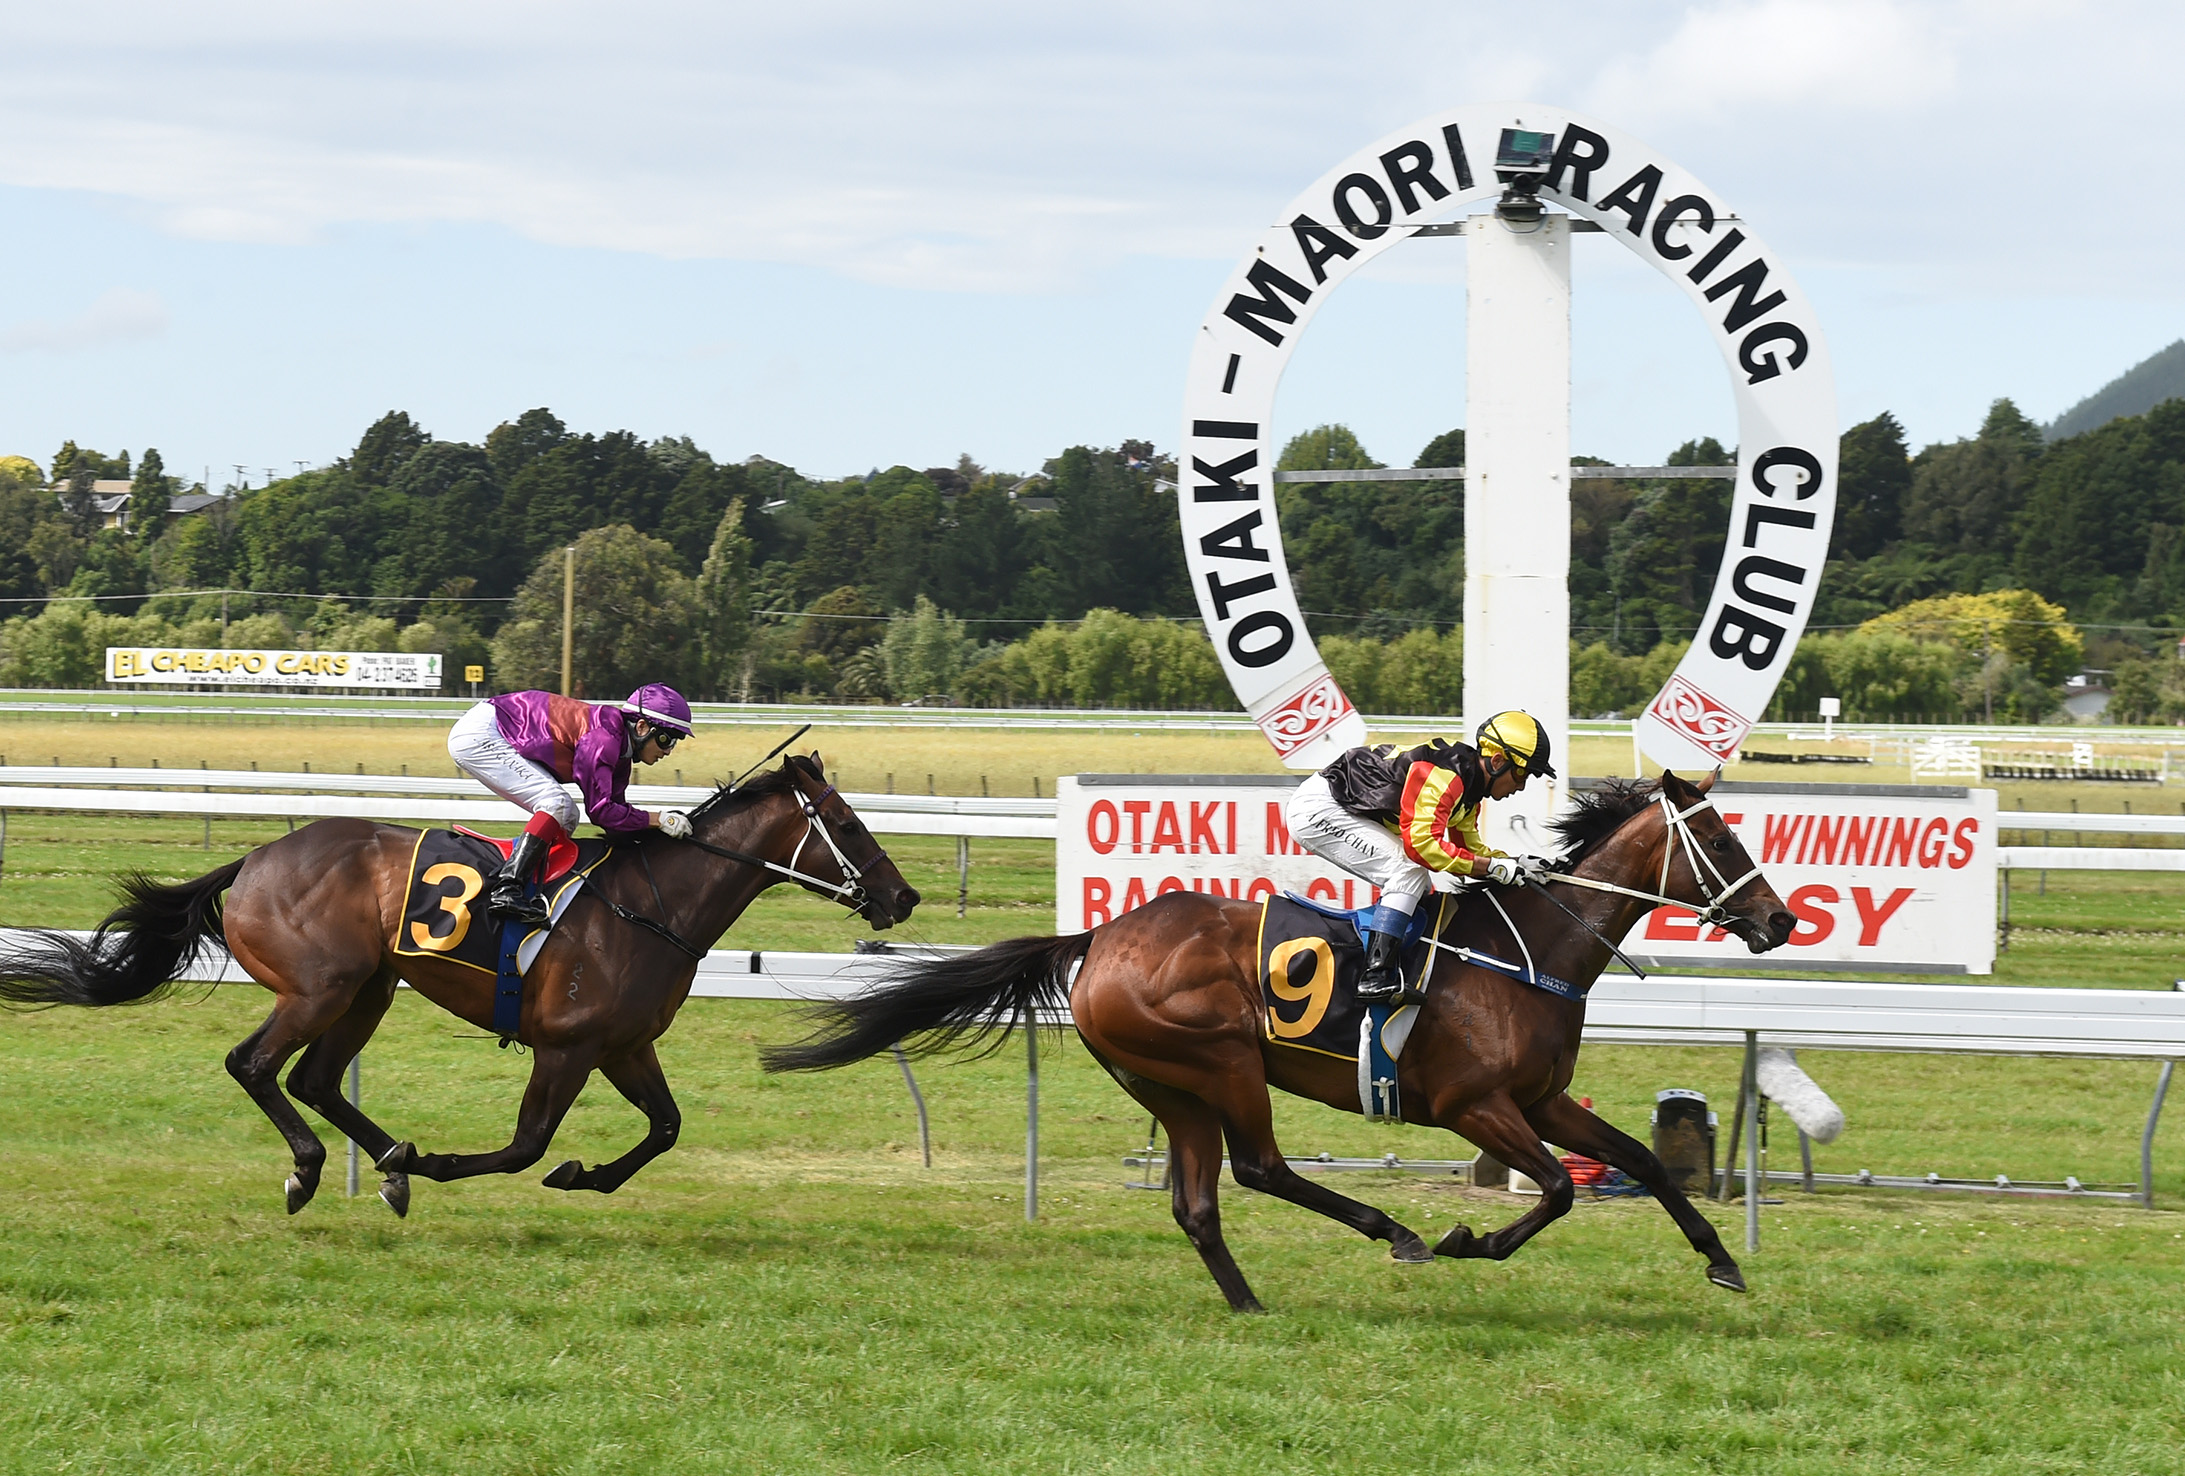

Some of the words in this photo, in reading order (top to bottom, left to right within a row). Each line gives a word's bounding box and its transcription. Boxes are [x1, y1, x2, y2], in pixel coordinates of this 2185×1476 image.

[1223, 123, 1475, 347] MAORI
[1541, 122, 1808, 386] RACING
[1192, 419, 1294, 668] OTAKI
[1709, 446, 1823, 671] CLUB
[114, 650, 149, 678] EL
[152, 651, 267, 674] CHEAPO
[276, 653, 350, 676] CARS
[1087, 799, 1237, 855] OTAKI
[1344, 833, 1379, 857] CHAN
[1761, 814, 1979, 869] WINNINGS
[410, 862, 483, 951] 3
[1644, 884, 1917, 947] ESY
[1268, 936, 1335, 1038] 9
[1539, 978, 1568, 992] CHAN
[1541, 974, 1570, 987] ALFRED
